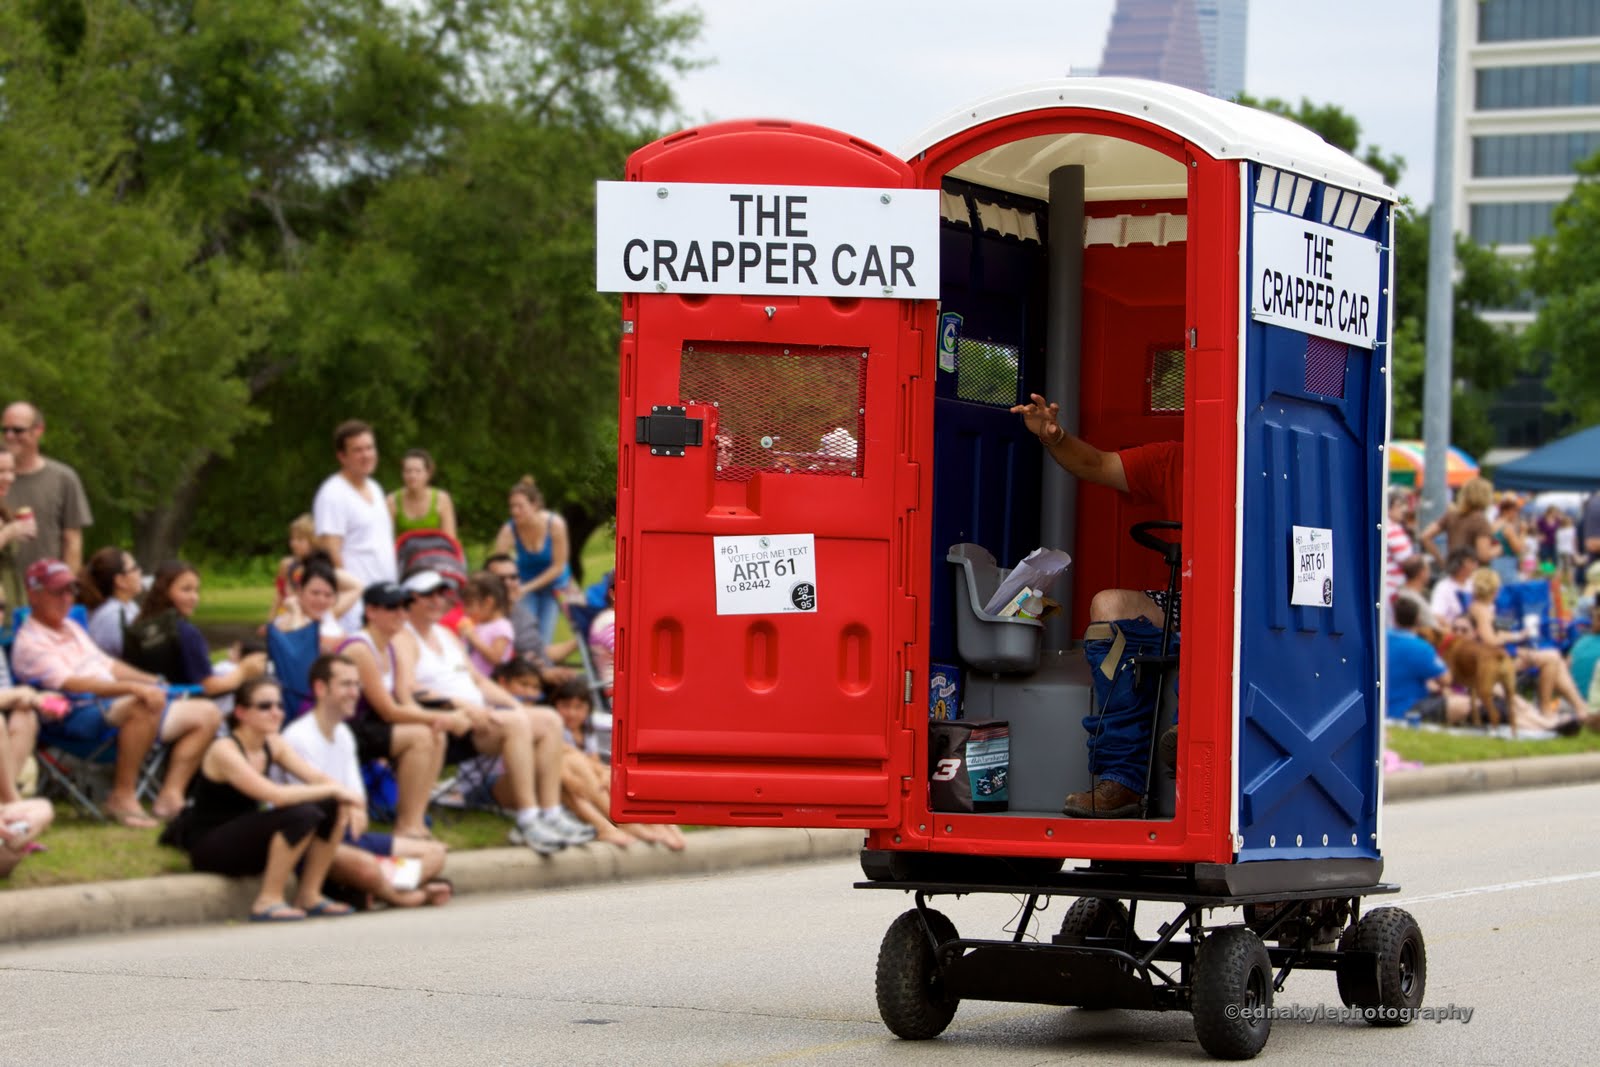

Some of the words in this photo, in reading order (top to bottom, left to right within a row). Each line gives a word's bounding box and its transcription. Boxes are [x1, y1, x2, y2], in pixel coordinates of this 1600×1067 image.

[730, 193, 808, 238] THE
[623, 238, 818, 285] CRAPPER
[831, 243, 917, 287] CAR
[1303, 231, 1334, 281] THE
[1262, 268, 1335, 328] CRAPPER
[1338, 289, 1370, 337] CAR
[721, 545, 739, 555] #61
[728, 553, 750, 563] VOTE
[751, 551, 768, 561] FOR
[770, 550, 785, 558] ME!
[788, 546, 808, 556] TEXT
[733, 560, 770, 582] ART
[774, 558, 795, 577] 61
[1300, 553, 1315, 572] ART
[1316, 552, 1326, 570] 61
[726, 584, 737, 593] to
[739, 579, 771, 592] 82442
[800, 599, 812, 609] 95
[932, 758, 962, 781] 3
